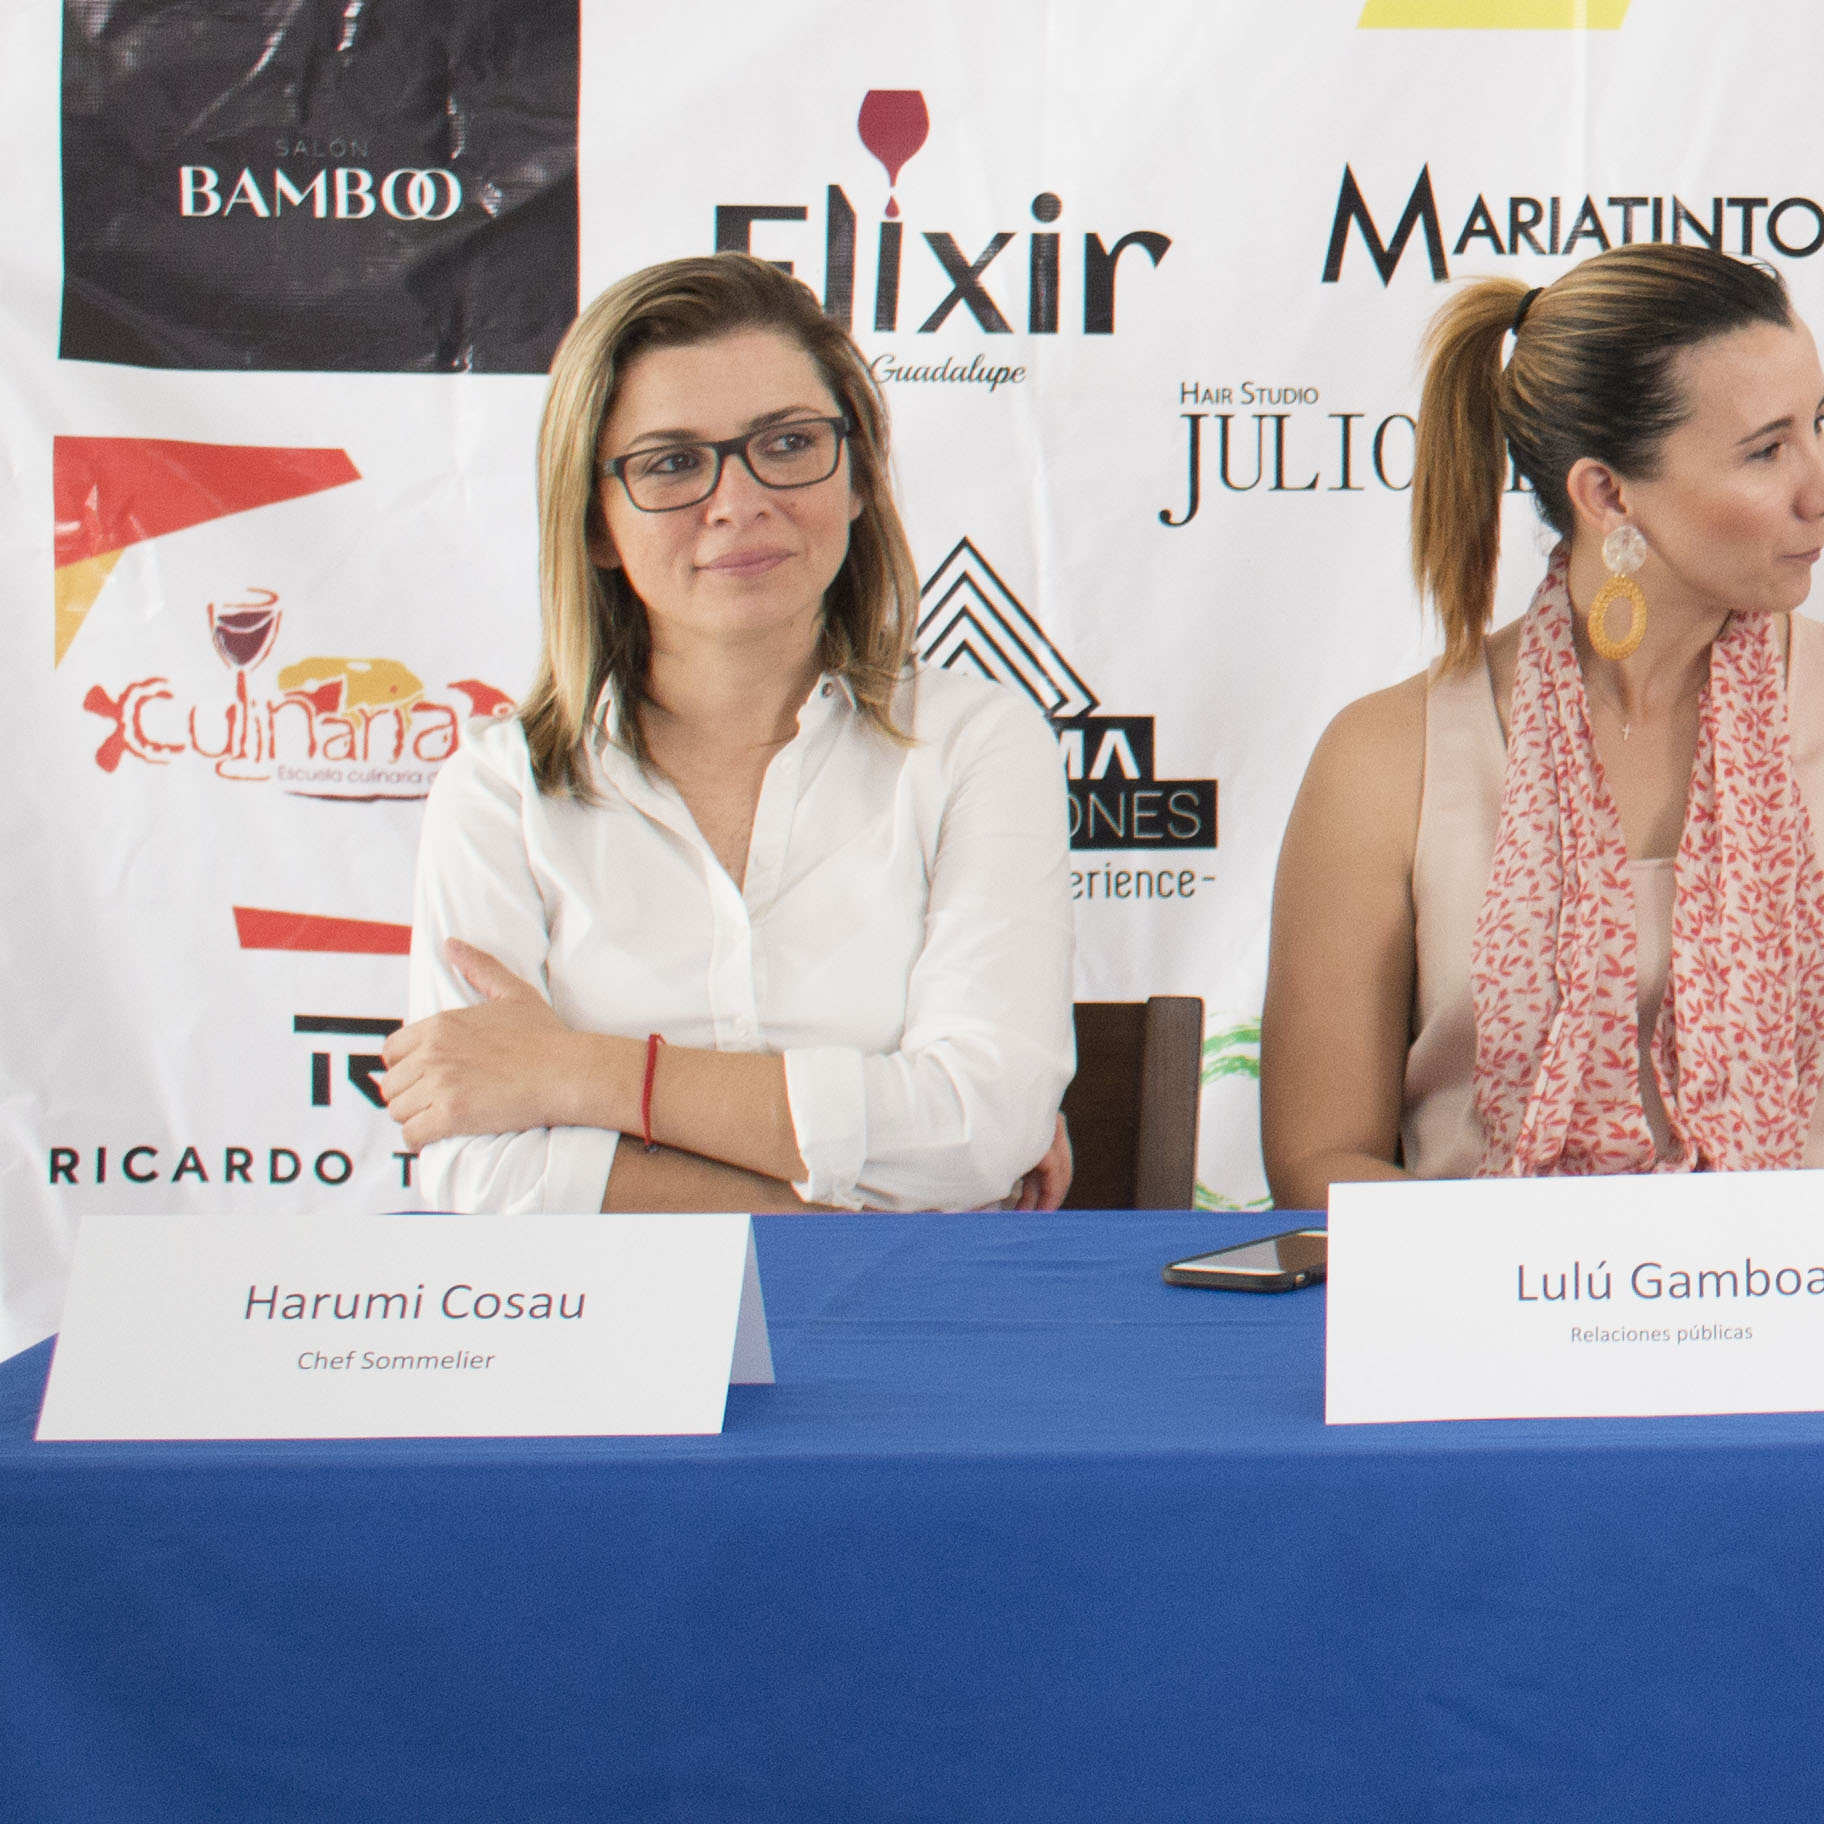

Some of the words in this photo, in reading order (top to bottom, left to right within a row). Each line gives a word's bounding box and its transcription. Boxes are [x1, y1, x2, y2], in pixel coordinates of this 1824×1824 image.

[179, 166, 462, 220] BAMBOO
[869, 353, 1027, 392] Guadalupe
[1158, 414, 1416, 527] JULIO
[279, 766, 341, 783] Escuela
[347, 765, 422, 783] culinaria
[49, 1146, 353, 1186] RICARDO
[1518, 1261, 1611, 1302] Lulú
[244, 1284, 424, 1325] Harumi
[441, 1284, 585, 1323] Cosau
[1571, 1325, 1670, 1344] Relaciones
[1677, 1324, 1753, 1347] públicas
[297, 1350, 353, 1373] Chef
[358, 1350, 495, 1373] Sommelier
